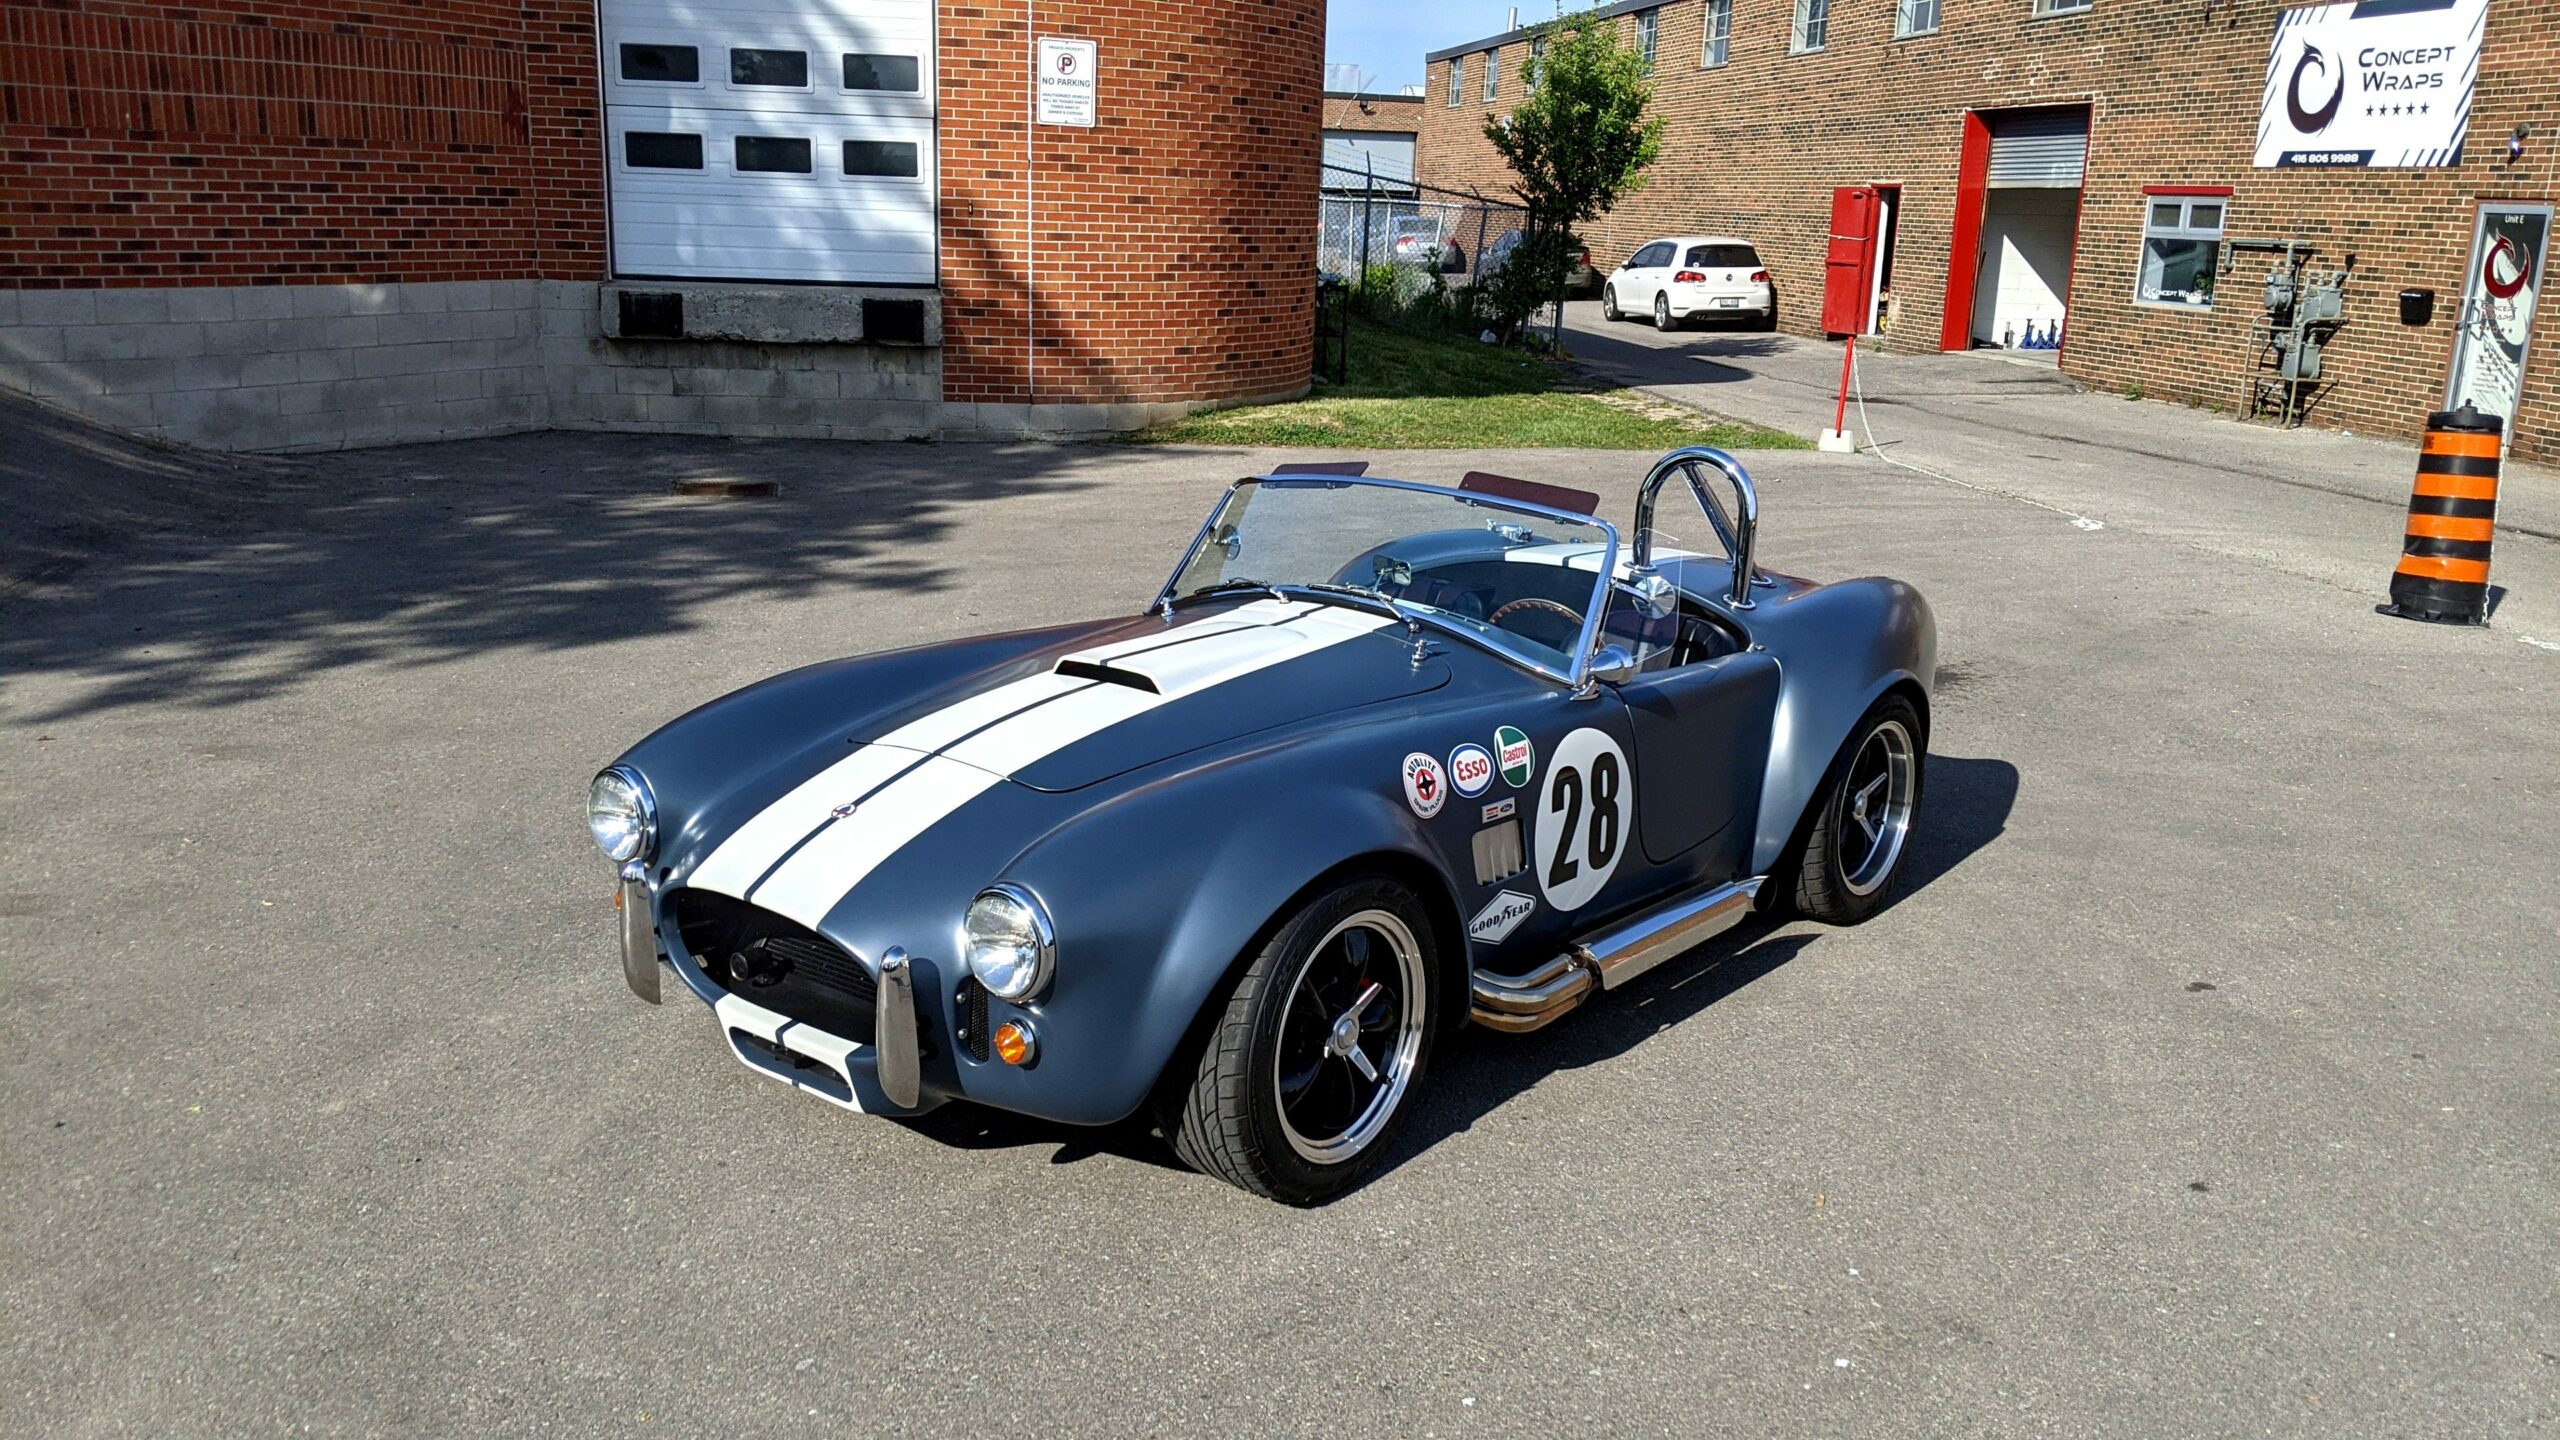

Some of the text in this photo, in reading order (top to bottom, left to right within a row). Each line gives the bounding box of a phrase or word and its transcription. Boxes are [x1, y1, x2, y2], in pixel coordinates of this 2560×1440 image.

[1042, 77, 1091, 88] NO PARKING
[2291, 153, 2359, 163] 416 806 9988
[2504, 214, 2525, 224] Unit E
[1502, 743, 1528, 763] Castrol
[1407, 757, 1437, 780] AUTOLITE
[1548, 751, 1620, 890] 28
